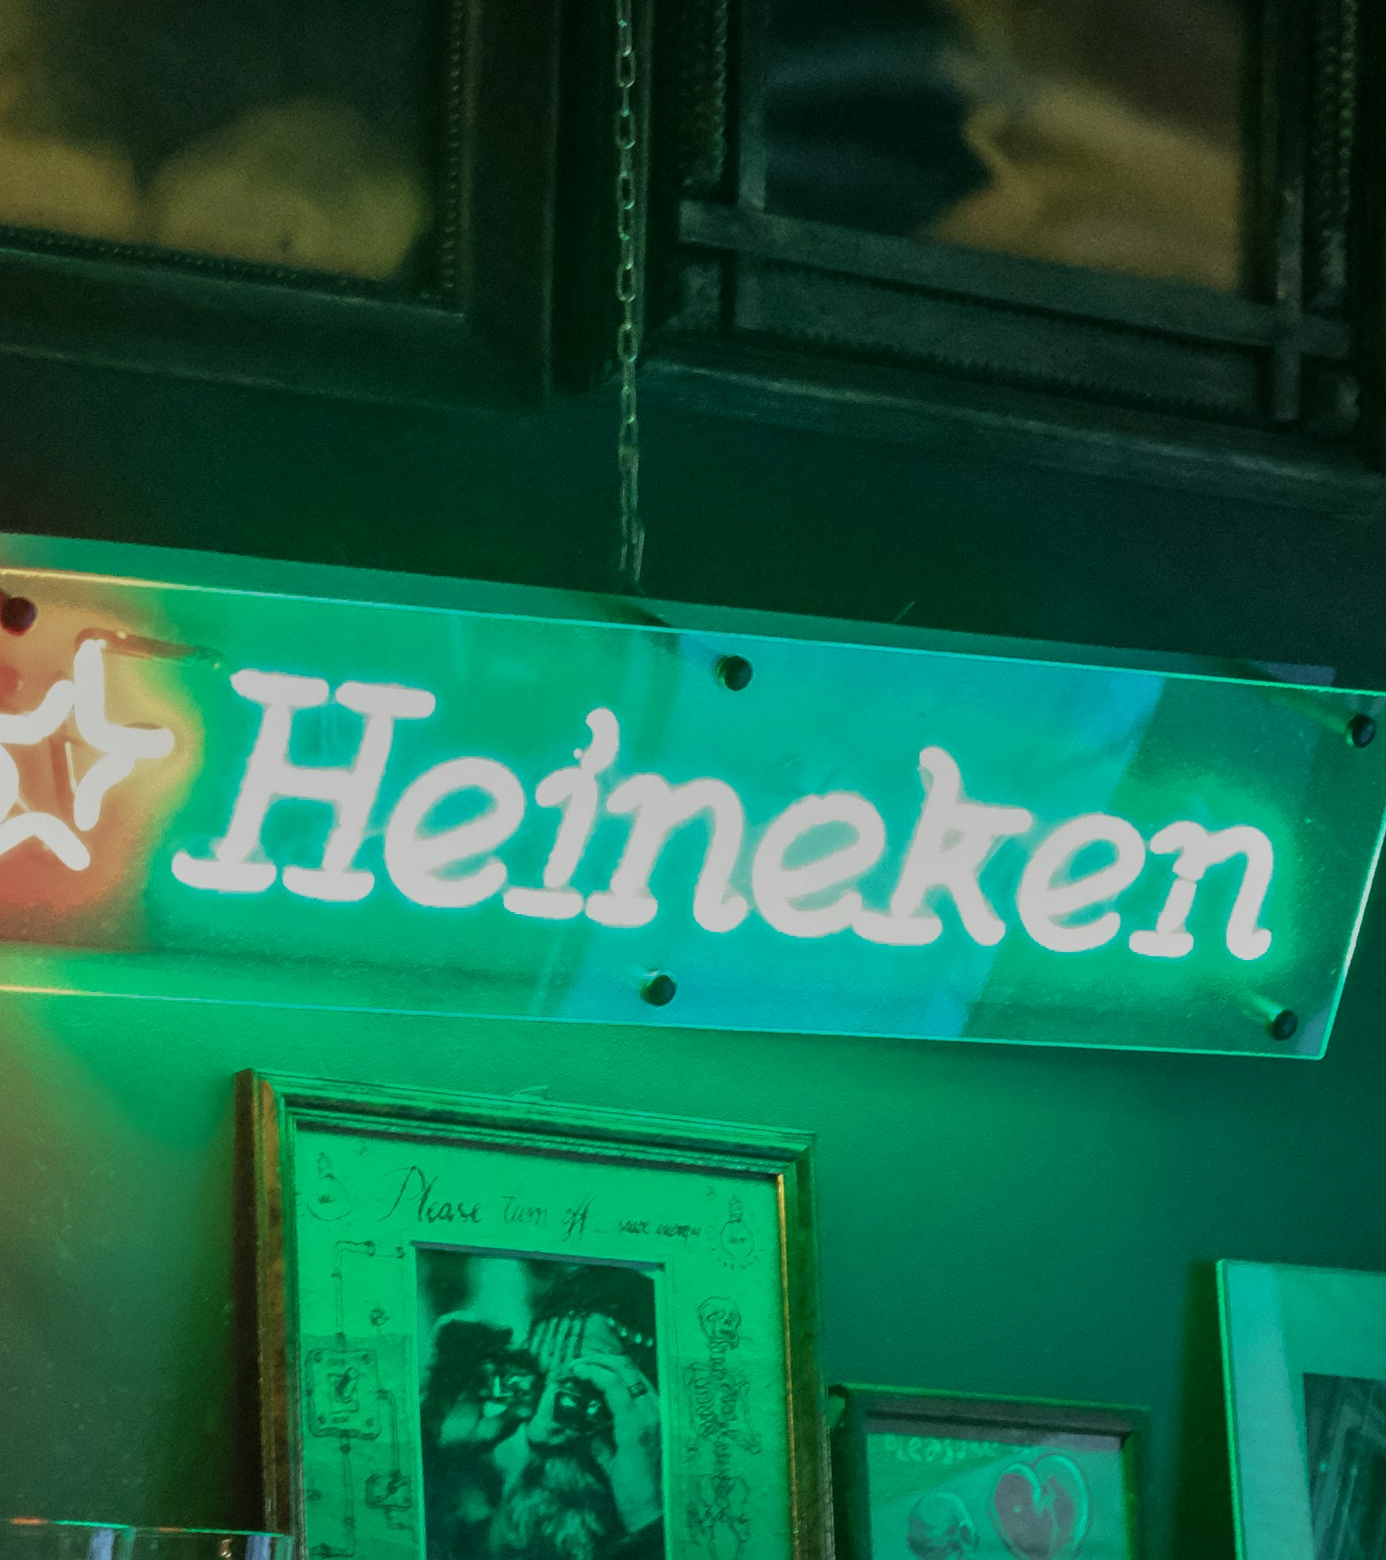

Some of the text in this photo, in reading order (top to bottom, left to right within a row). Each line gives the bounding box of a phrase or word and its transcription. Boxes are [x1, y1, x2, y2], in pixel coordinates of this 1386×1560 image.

[172, 669, 1274, 961] Heineken
[377, 1165, 483, 1225] Please
[500, 1194, 550, 1226] turn
